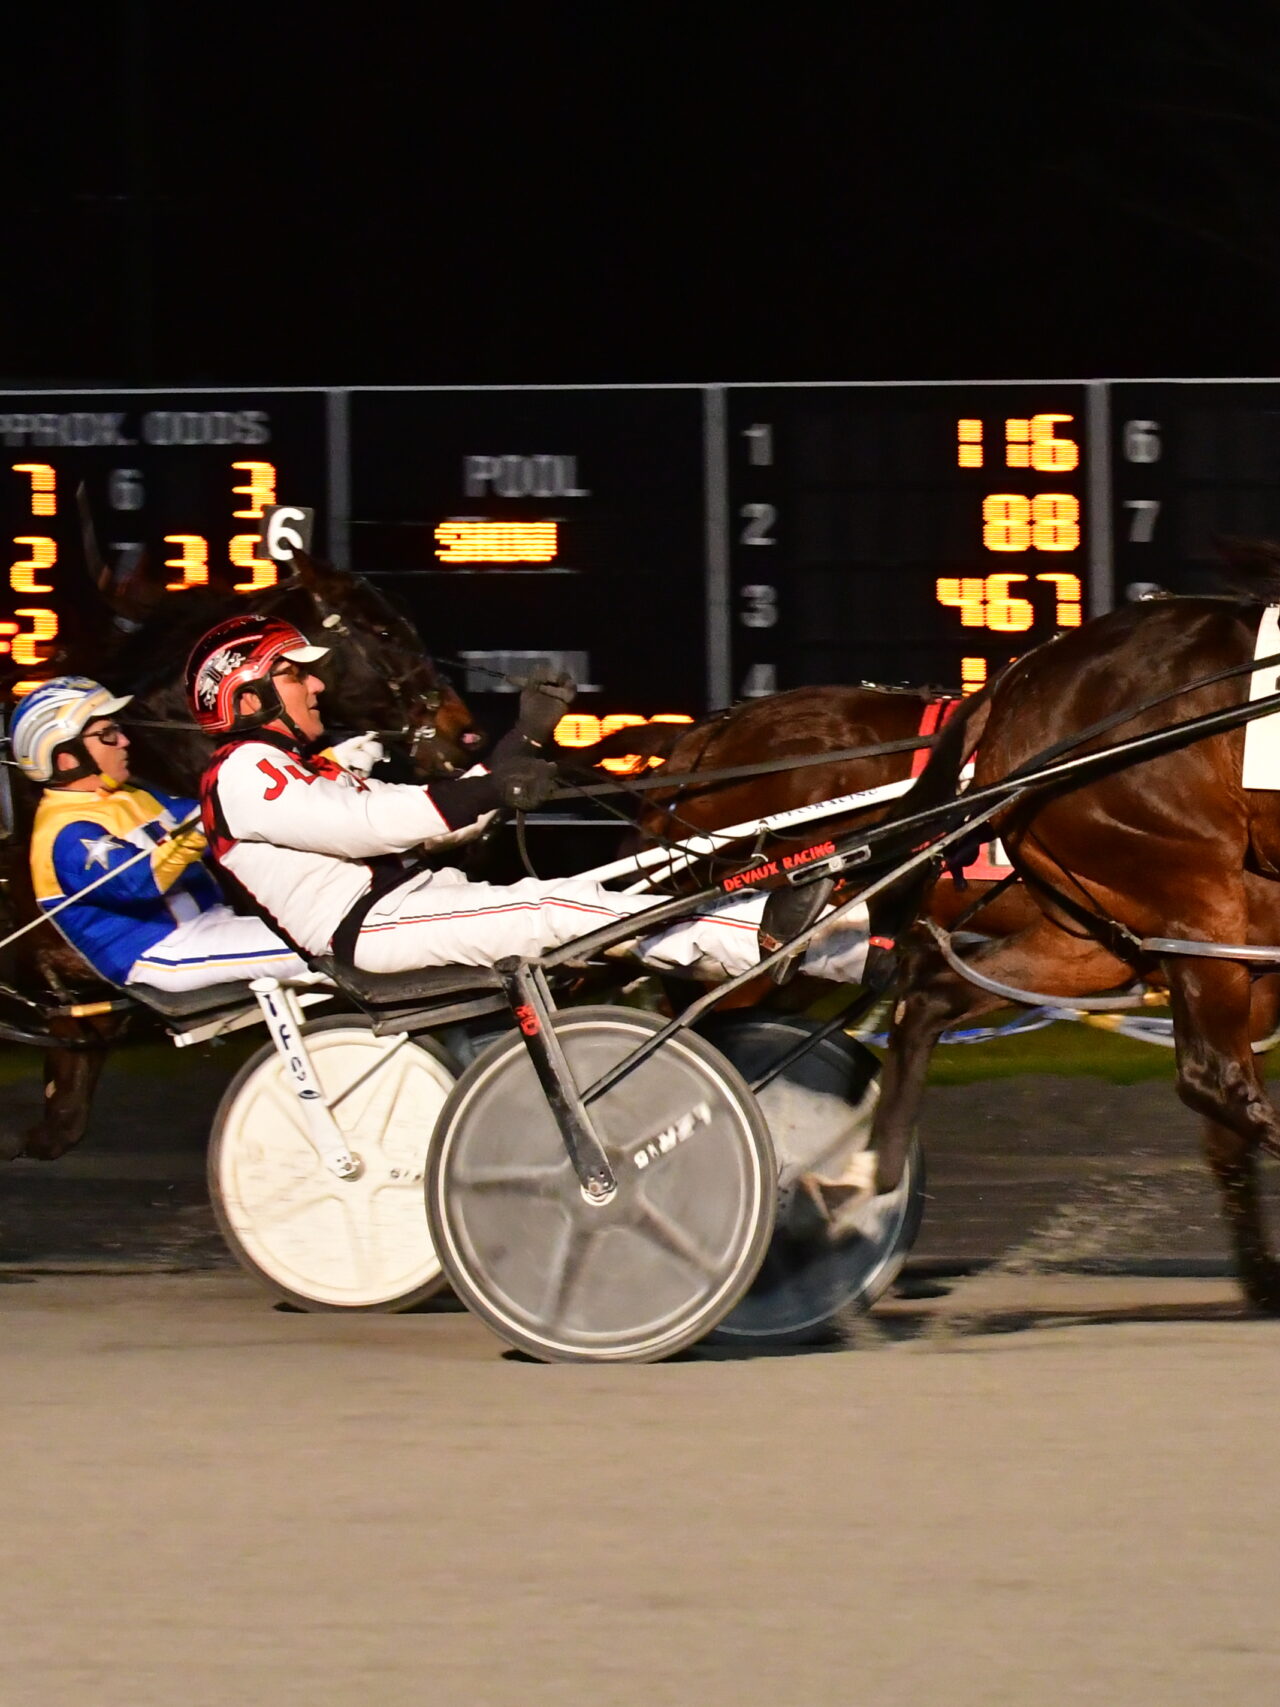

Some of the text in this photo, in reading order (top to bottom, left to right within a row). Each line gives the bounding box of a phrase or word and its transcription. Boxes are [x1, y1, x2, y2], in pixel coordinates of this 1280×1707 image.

[143, 411, 270, 445] ODDS
[742, 424, 774, 465] 1
[1123, 420, 1162, 463] 6
[108, 468, 146, 511] 6
[231, 461, 277, 519] 3
[461, 455, 592, 498] POOL
[267, 507, 306, 561] 6
[740, 503, 777, 546] 2
[982, 494, 1081, 551] 88
[1123, 500, 1160, 543] 7
[740, 585, 778, 628] 3
[935, 573, 1083, 632] 467
[722, 840, 836, 893] DEVAUX RACING
